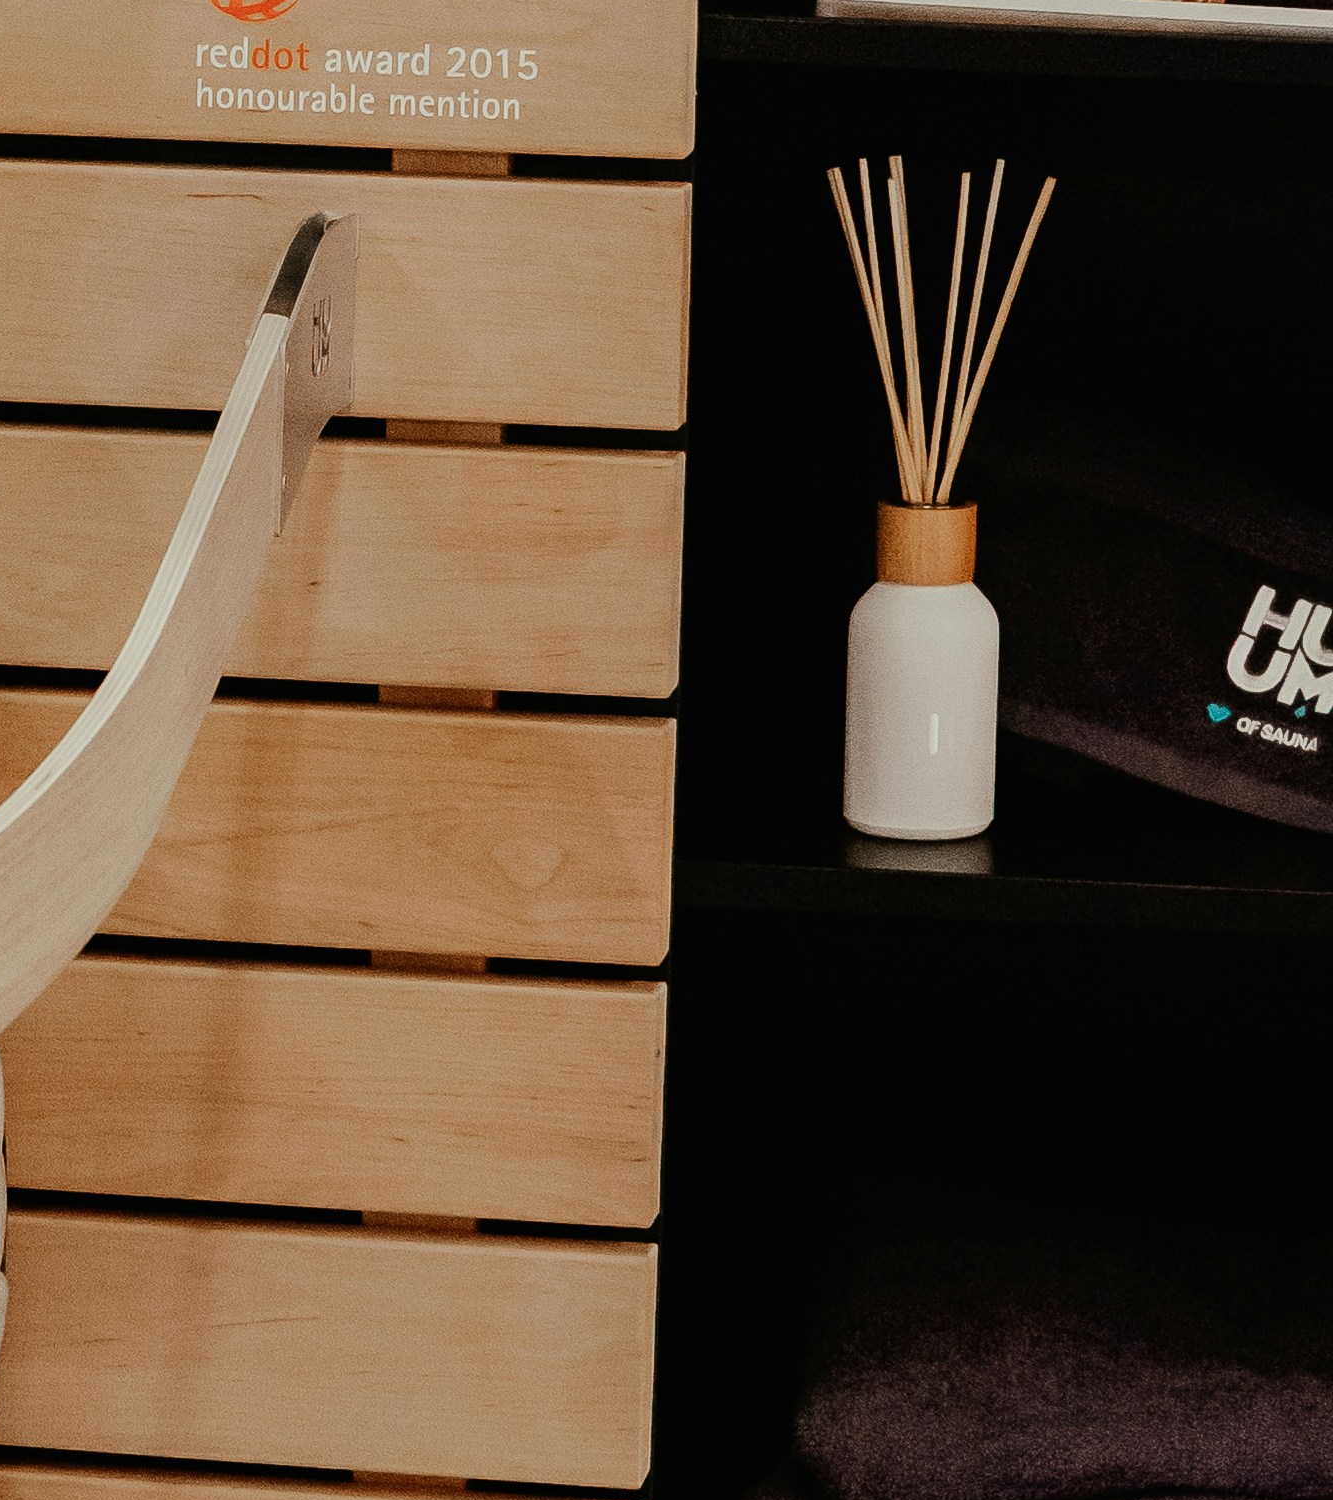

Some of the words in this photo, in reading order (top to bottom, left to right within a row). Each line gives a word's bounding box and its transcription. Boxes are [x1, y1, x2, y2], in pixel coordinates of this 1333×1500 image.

[195, 36, 310, 71] reddot
[324, 44, 432, 76] award
[446, 46, 539, 81] 2015
[196, 79, 375, 116] honourable
[388, 89, 521, 121] mention
[1236, 717, 1262, 735] OF
[1260, 723, 1318, 752] SAUNA
